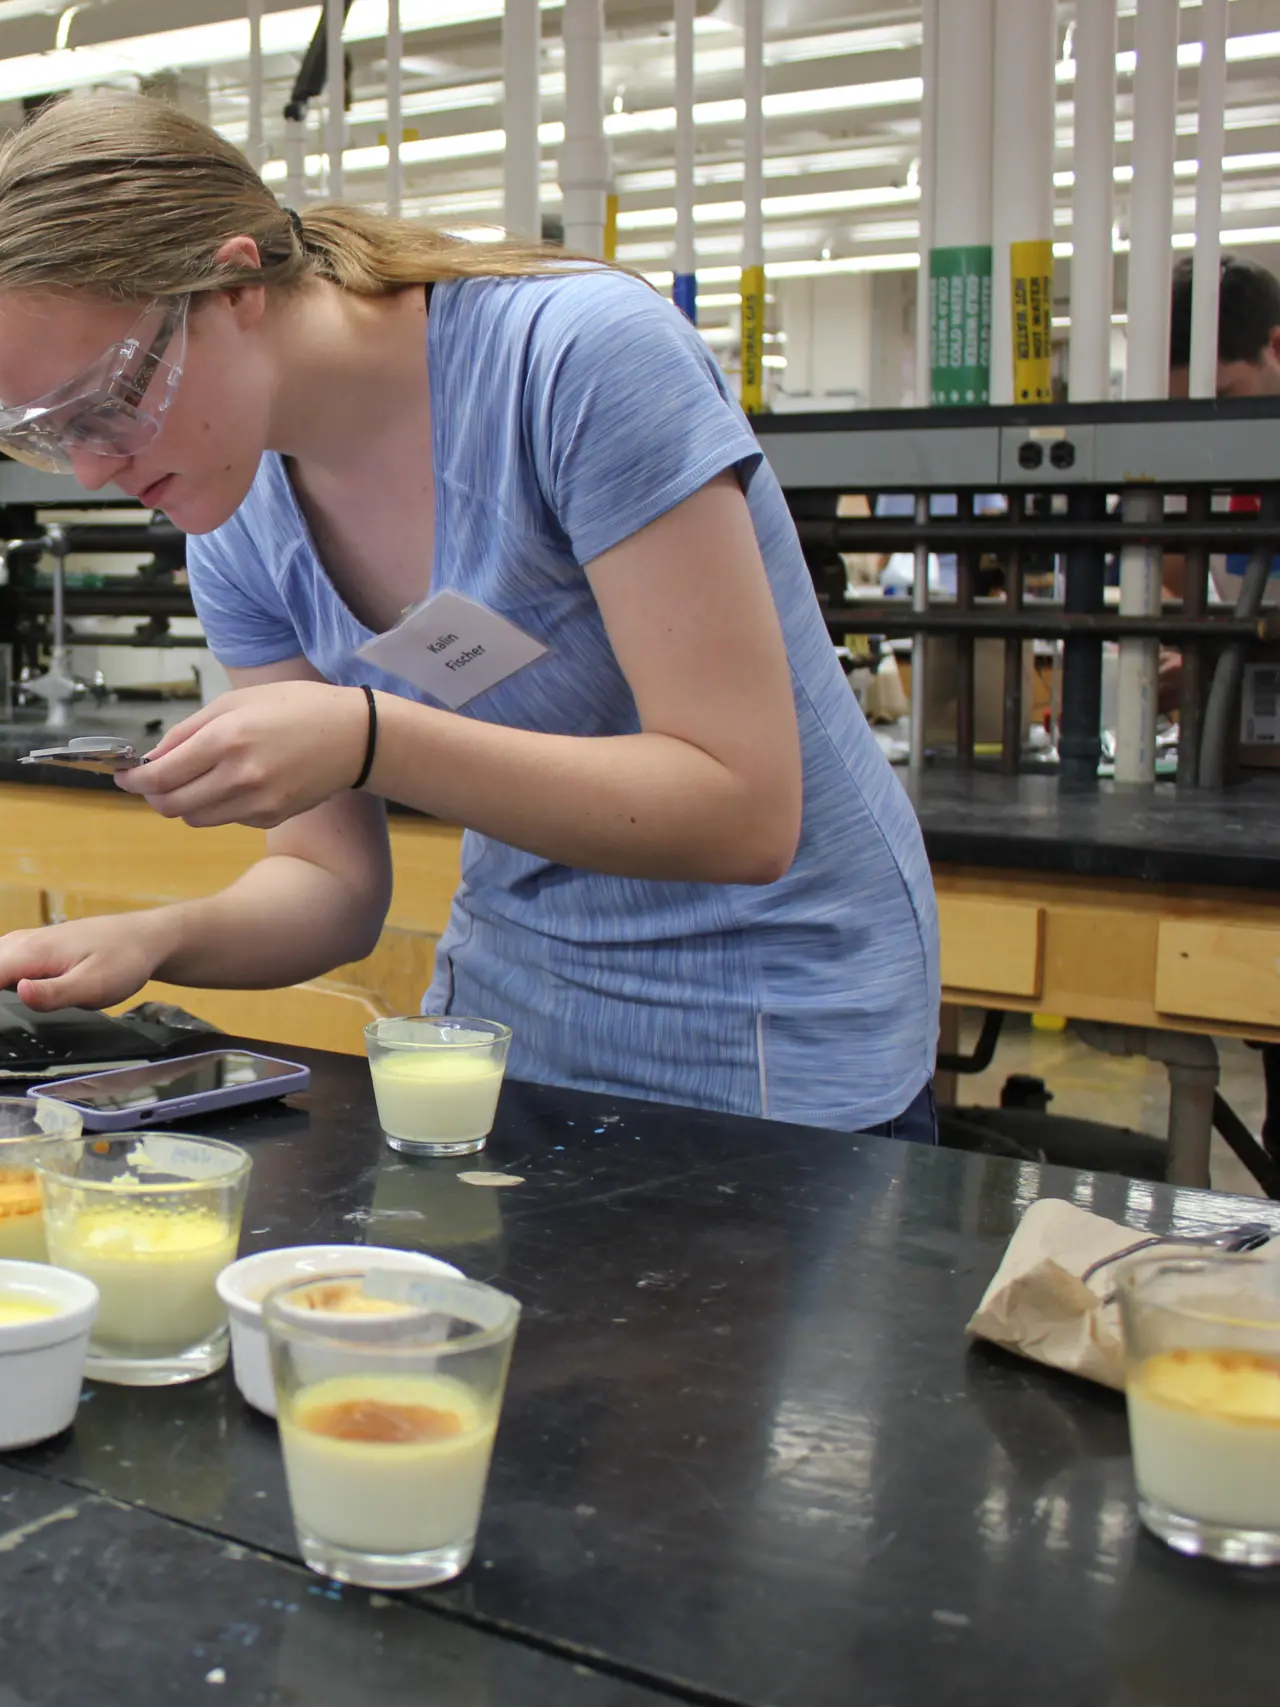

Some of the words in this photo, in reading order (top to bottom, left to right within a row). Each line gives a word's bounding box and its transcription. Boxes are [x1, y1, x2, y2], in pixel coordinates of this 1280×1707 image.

[951, 275, 964, 325] WATER
[951, 328, 964, 368] COLD
[427, 633, 459, 654] Kalin
[445, 644, 486, 672] Fischer
